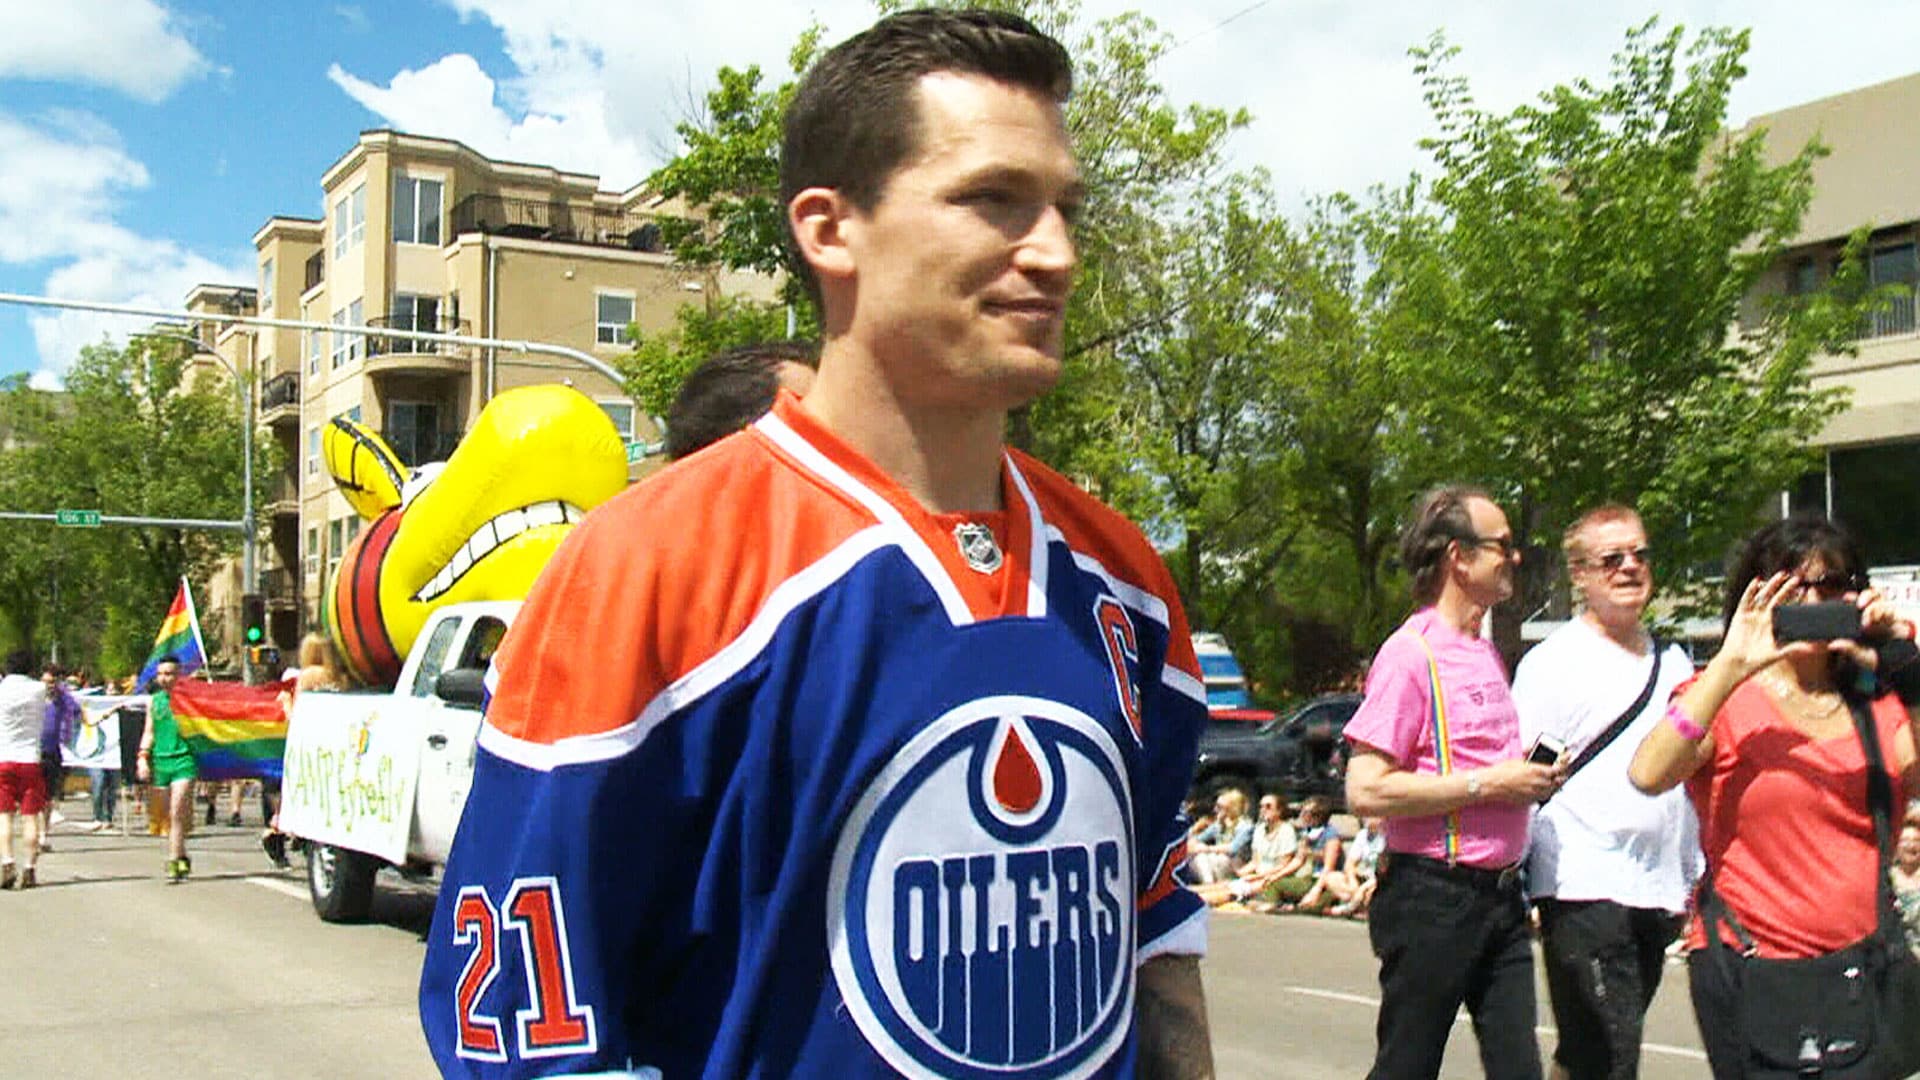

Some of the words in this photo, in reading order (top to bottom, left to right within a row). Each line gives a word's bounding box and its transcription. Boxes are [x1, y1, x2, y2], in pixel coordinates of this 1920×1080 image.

[1093, 594, 1143, 748] C
[453, 876, 597, 1063] 21
[893, 839, 1120, 1020] OILERS
